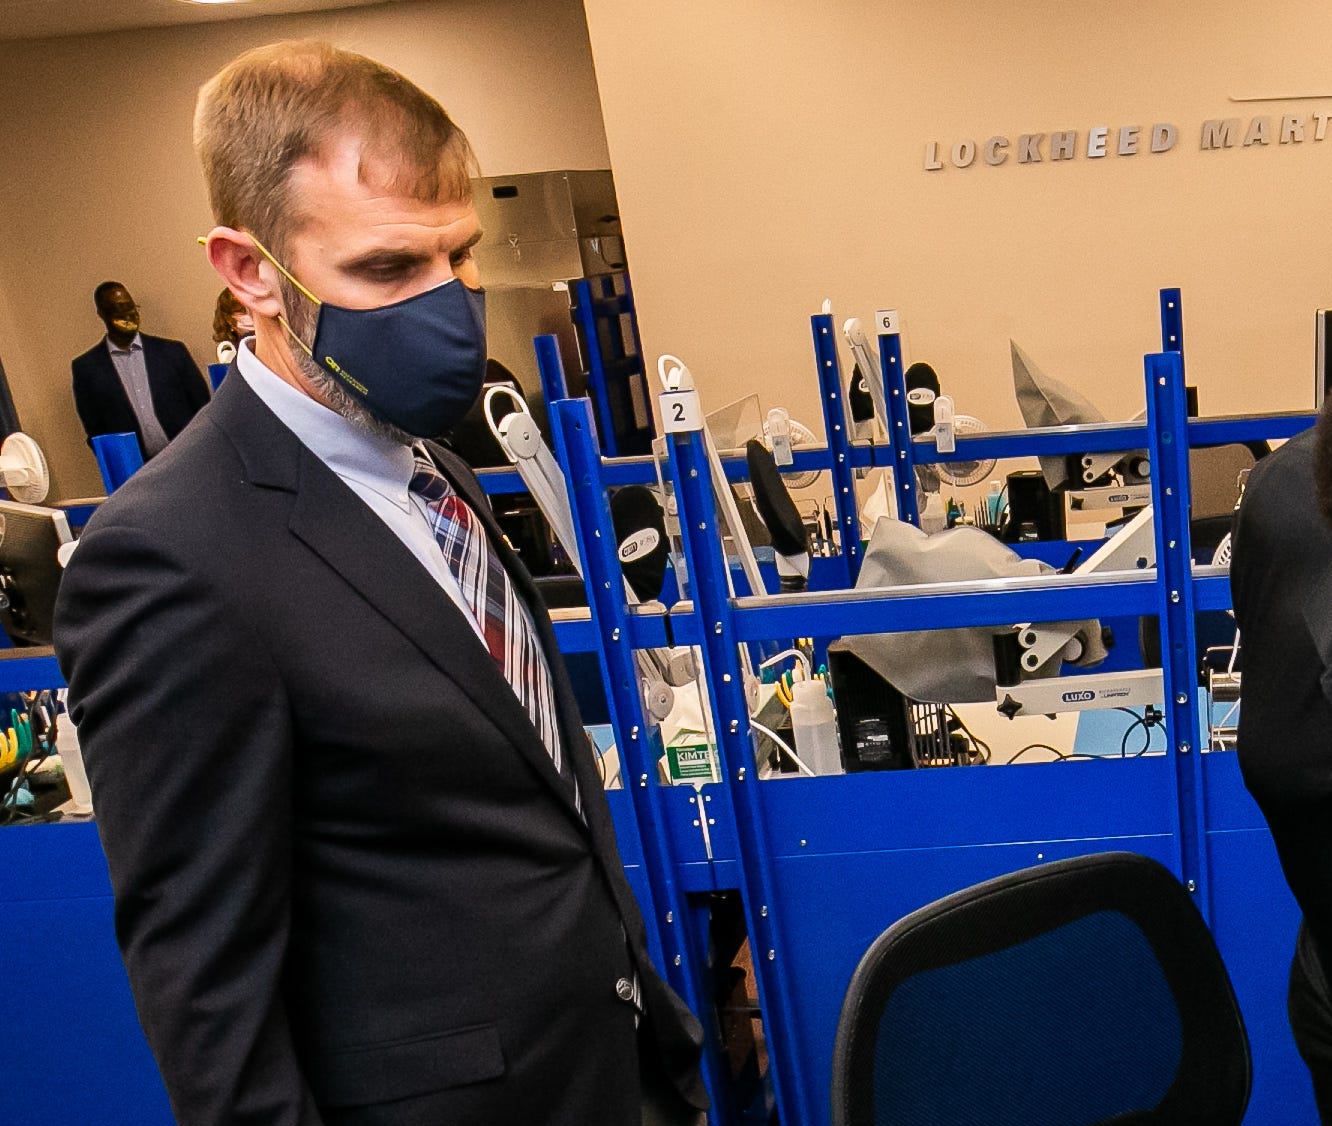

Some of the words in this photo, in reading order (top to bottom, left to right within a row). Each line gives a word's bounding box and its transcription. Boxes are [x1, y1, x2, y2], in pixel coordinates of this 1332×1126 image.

[924, 121, 1179, 171] LOCKHEED
[882, 316, 891, 328] 6
[672, 402, 686, 422] 2
[1065, 690, 1092, 702] LUXO
[677, 750, 713, 762] KIMTE
